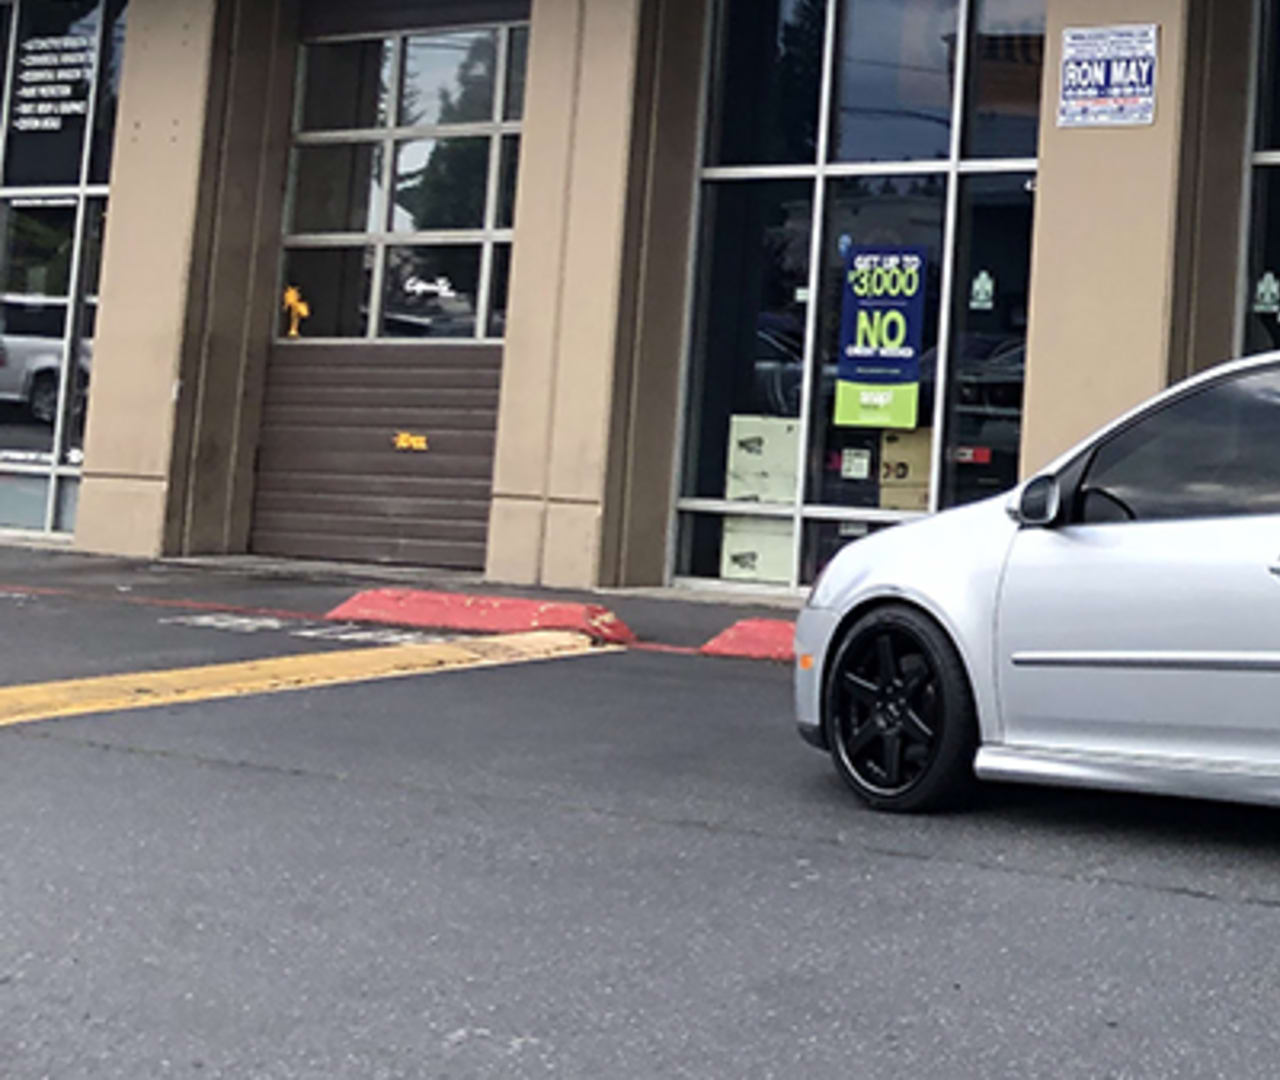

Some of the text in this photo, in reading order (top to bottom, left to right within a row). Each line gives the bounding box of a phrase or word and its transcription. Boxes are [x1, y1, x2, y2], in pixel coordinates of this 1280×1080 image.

[1064, 58, 1153, 88] RON MAY
[853, 255, 921, 270] GET UP TO
[857, 310, 906, 350] NO
